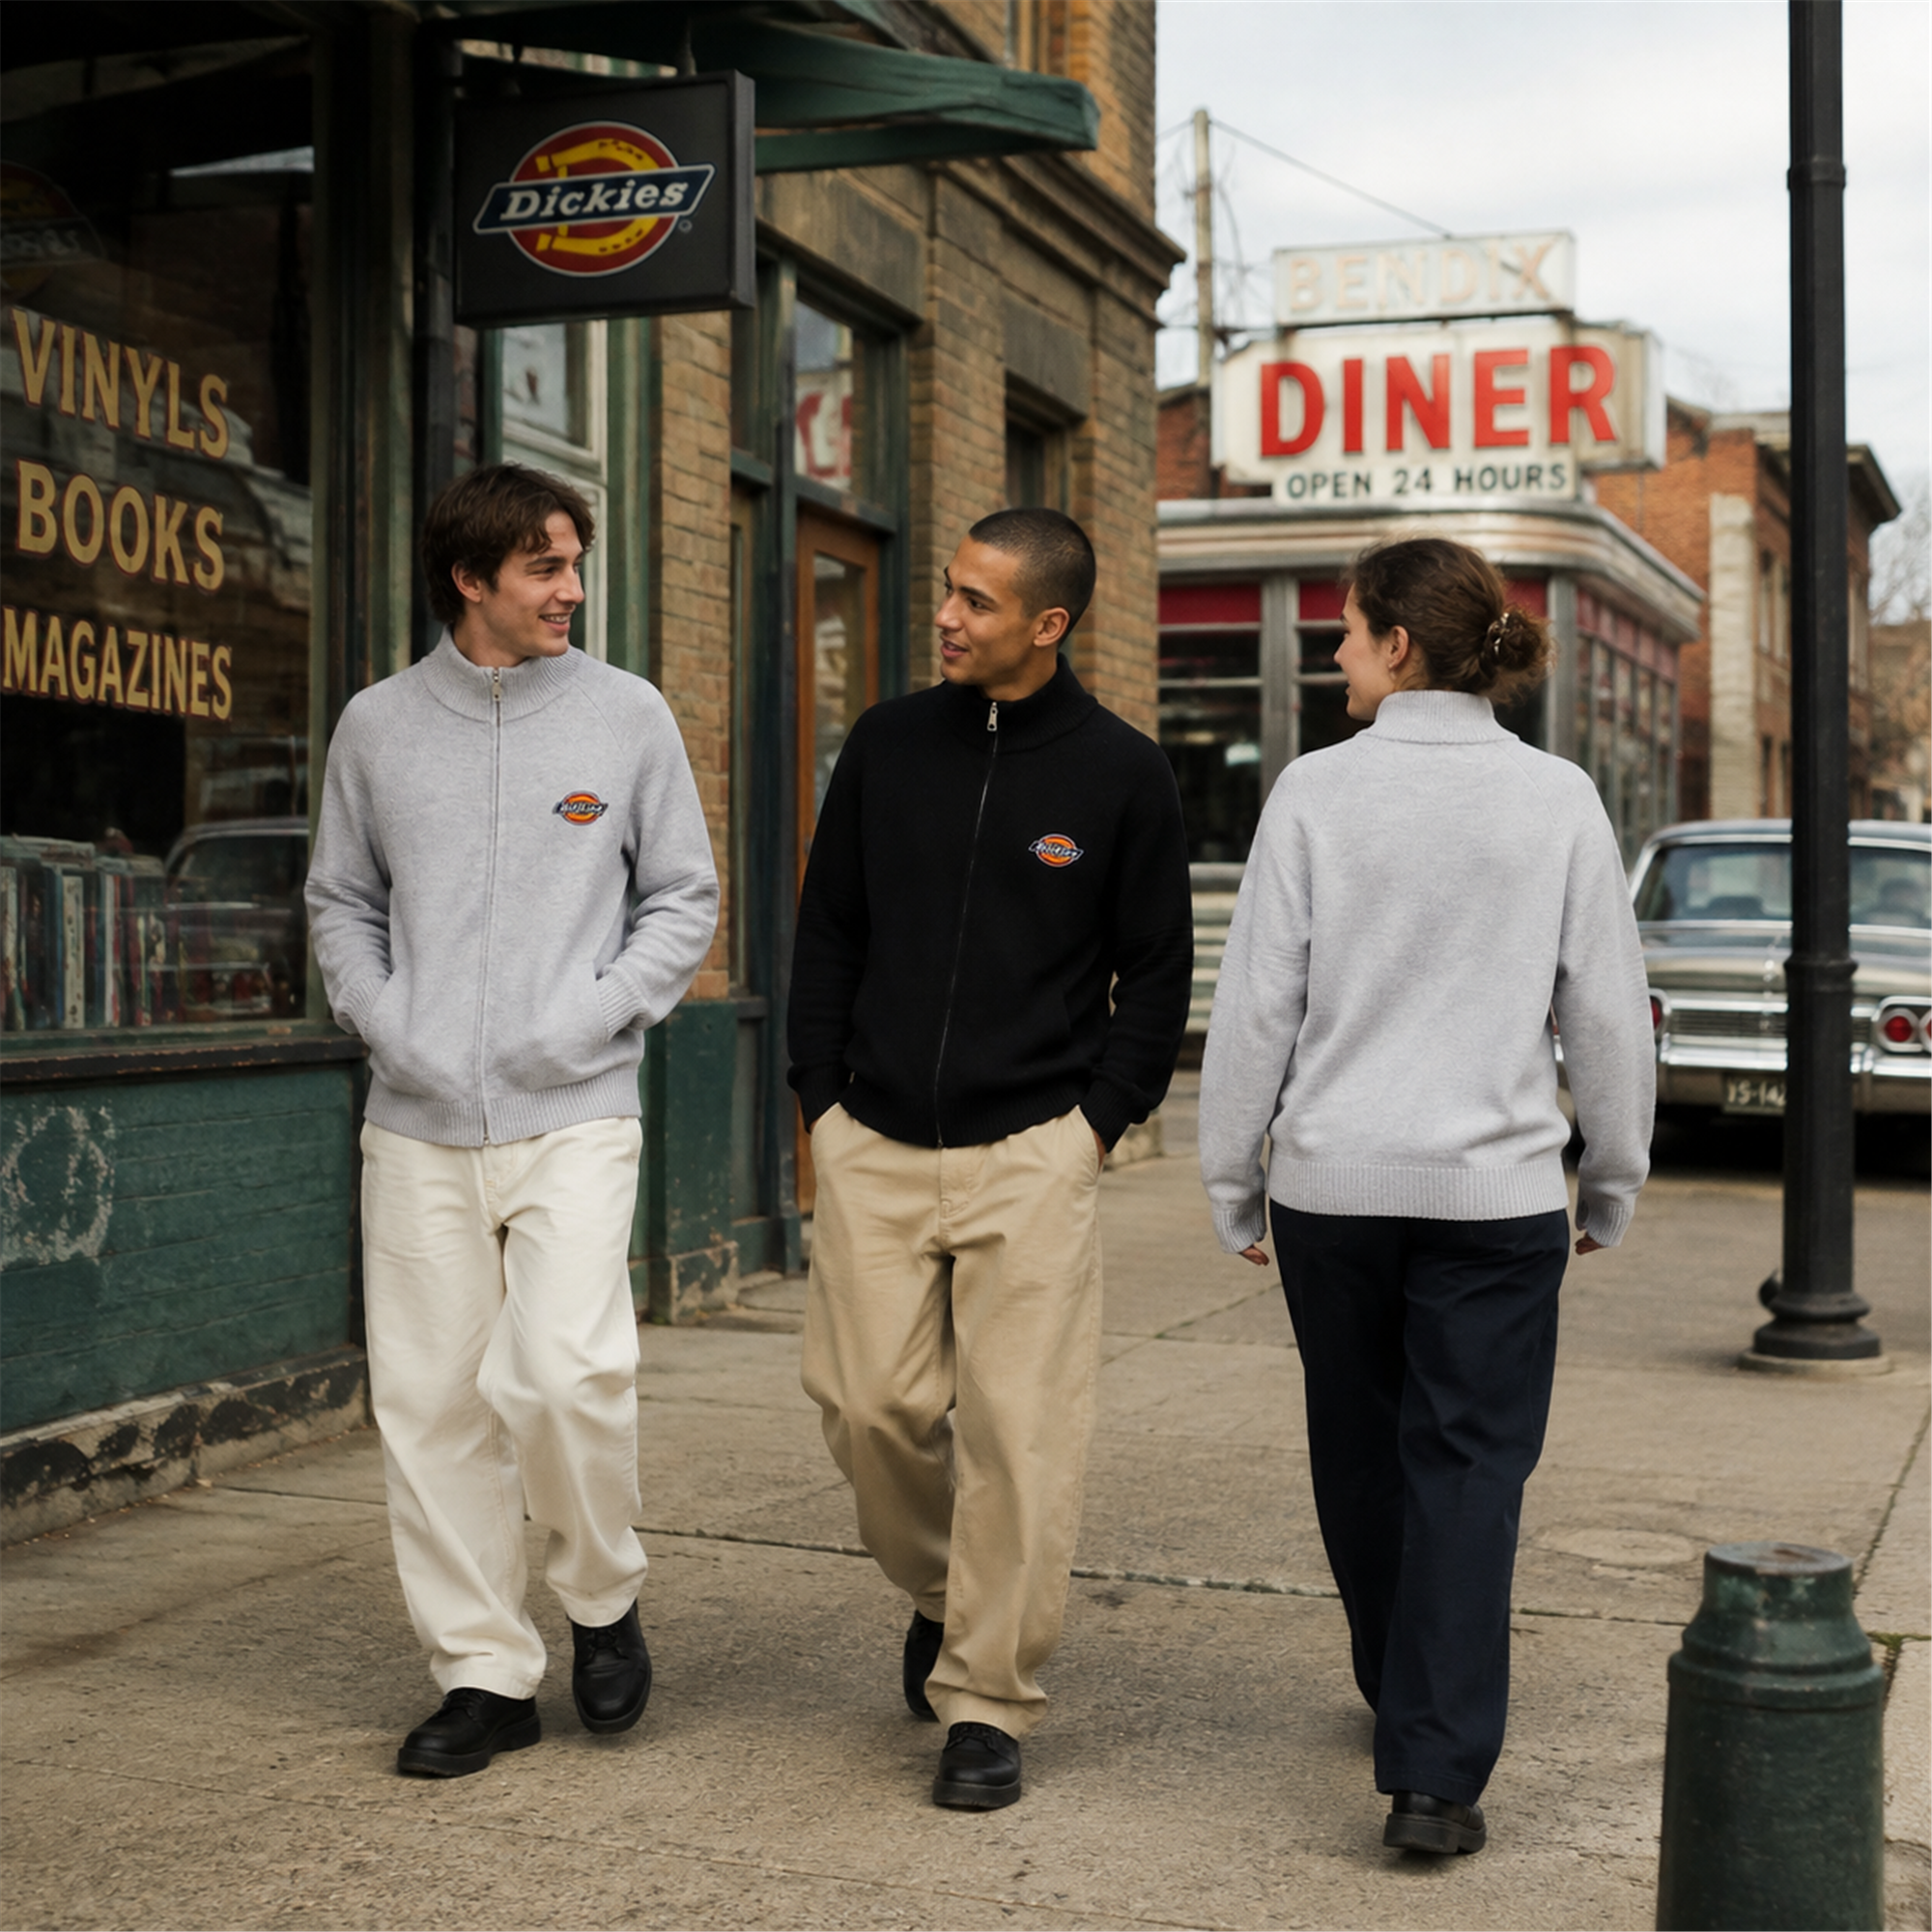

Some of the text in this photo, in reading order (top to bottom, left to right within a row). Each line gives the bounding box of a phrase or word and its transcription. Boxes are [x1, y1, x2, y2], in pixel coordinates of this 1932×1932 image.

[498, 178, 689, 221] Dickies
[1288, 238, 1554, 312] BENDIX
[11, 306, 230, 460] VINYLS
[1261, 344, 1617, 458] DINER
[17, 458, 225, 593] BOOKS
[1286, 462, 1568, 499] OPEN 24 HOURS
[2, 605, 234, 722] MAGAZINES
